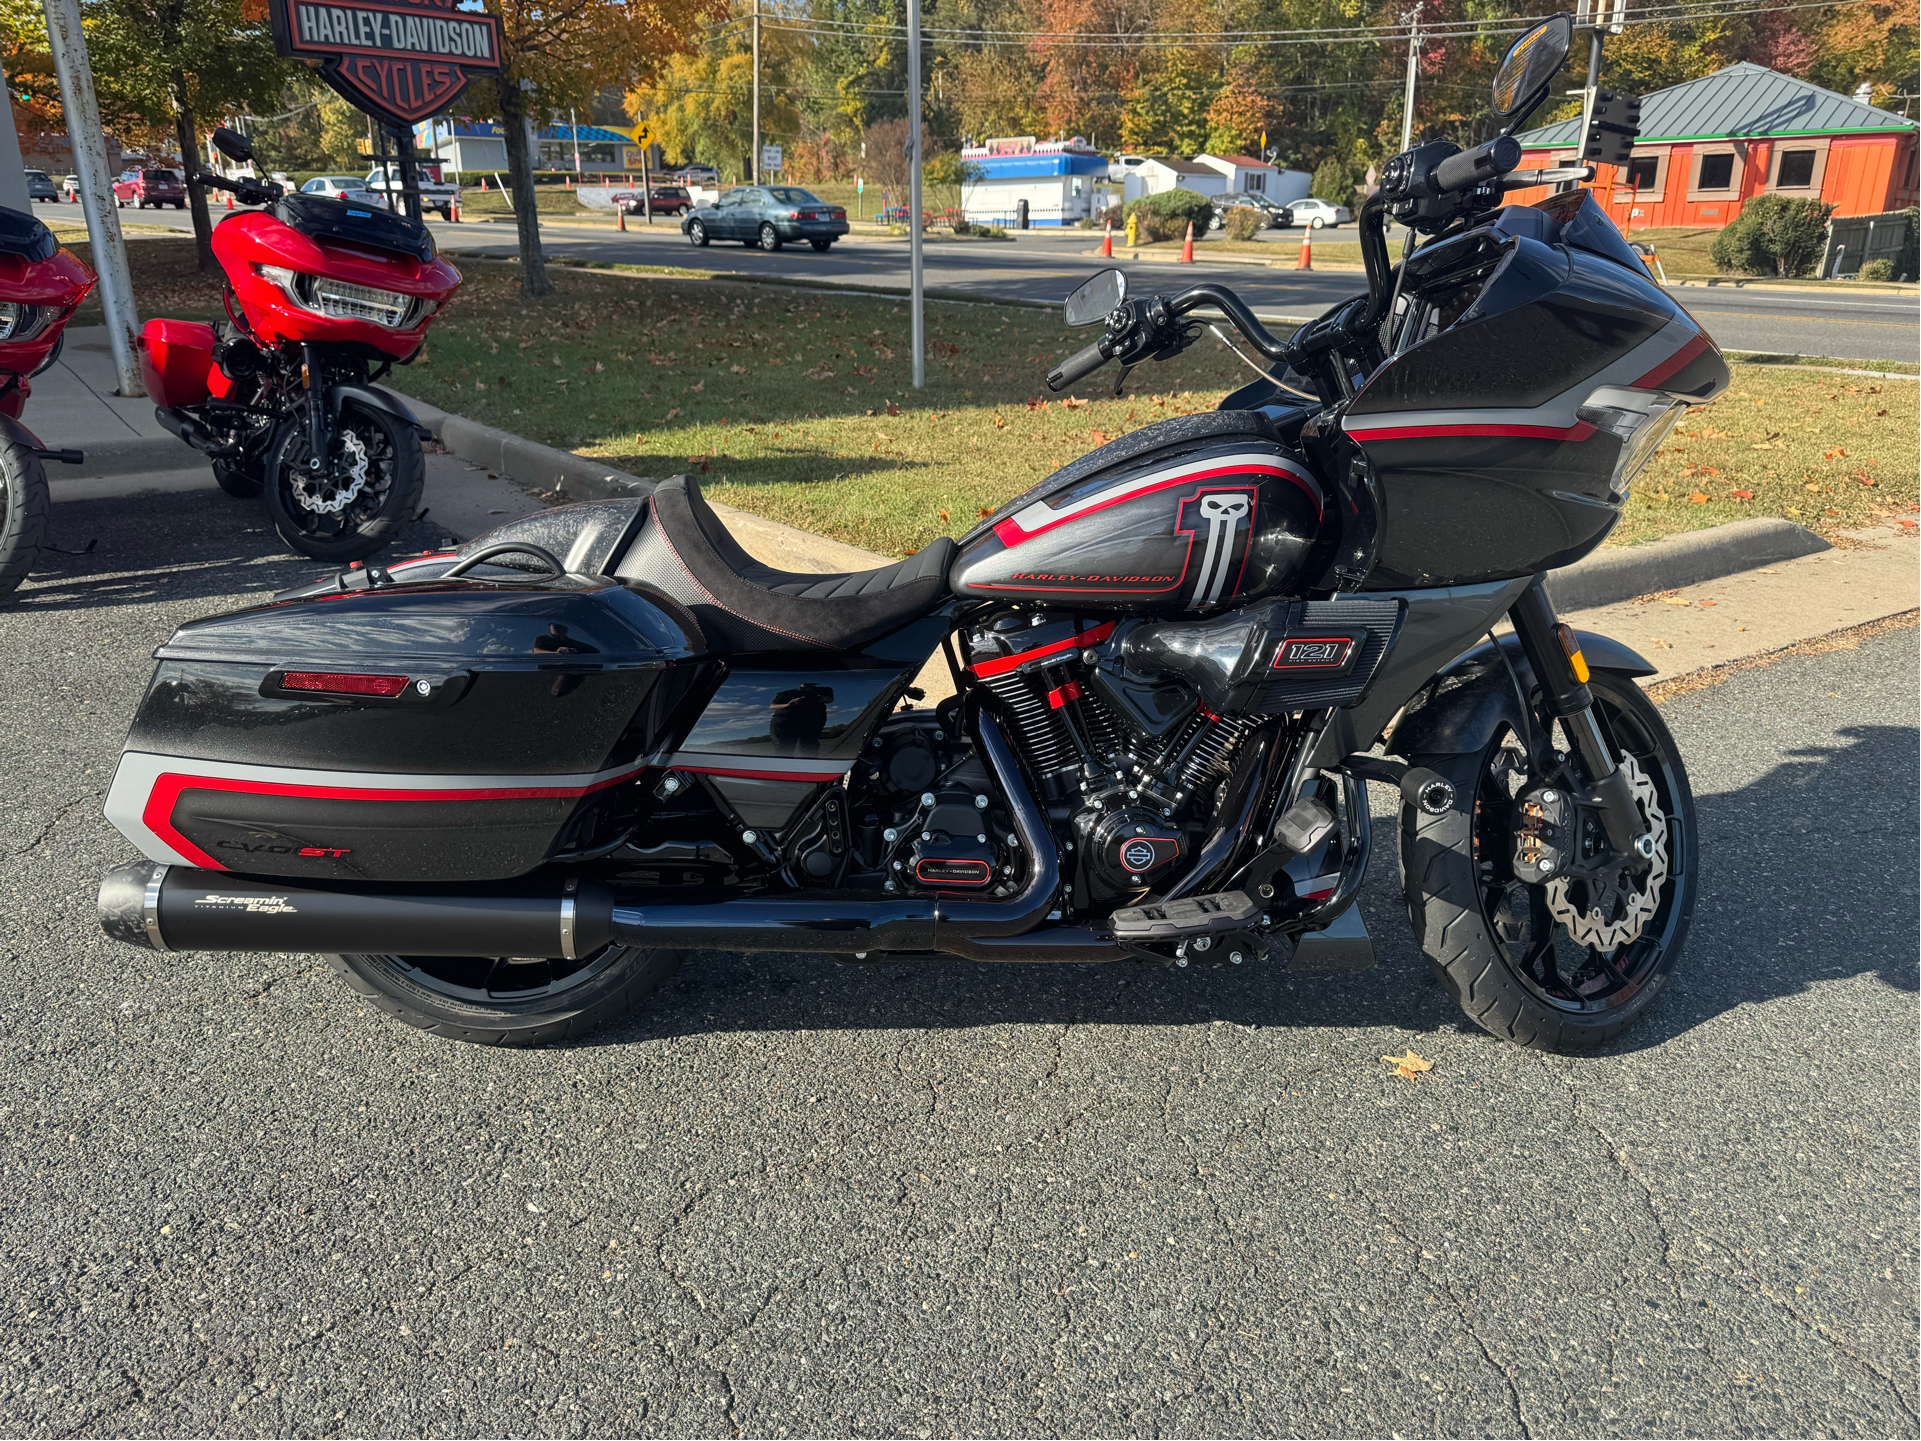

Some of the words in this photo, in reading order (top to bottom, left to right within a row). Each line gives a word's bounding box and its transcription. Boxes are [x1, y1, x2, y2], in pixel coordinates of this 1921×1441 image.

[299, 5, 490, 58] HARLEY-DAVIDSON
[355, 57, 451, 110] CYCLES
[1012, 572, 1175, 583] HARLEY-DAVIDSON
[1289, 643, 1339, 660] 121
[1425, 782, 1454, 793] HARLEY
[1422, 799, 1454, 813] DAVIDSON
[195, 895, 288, 905] Screamin'
[246, 904, 298, 914] Eagle
